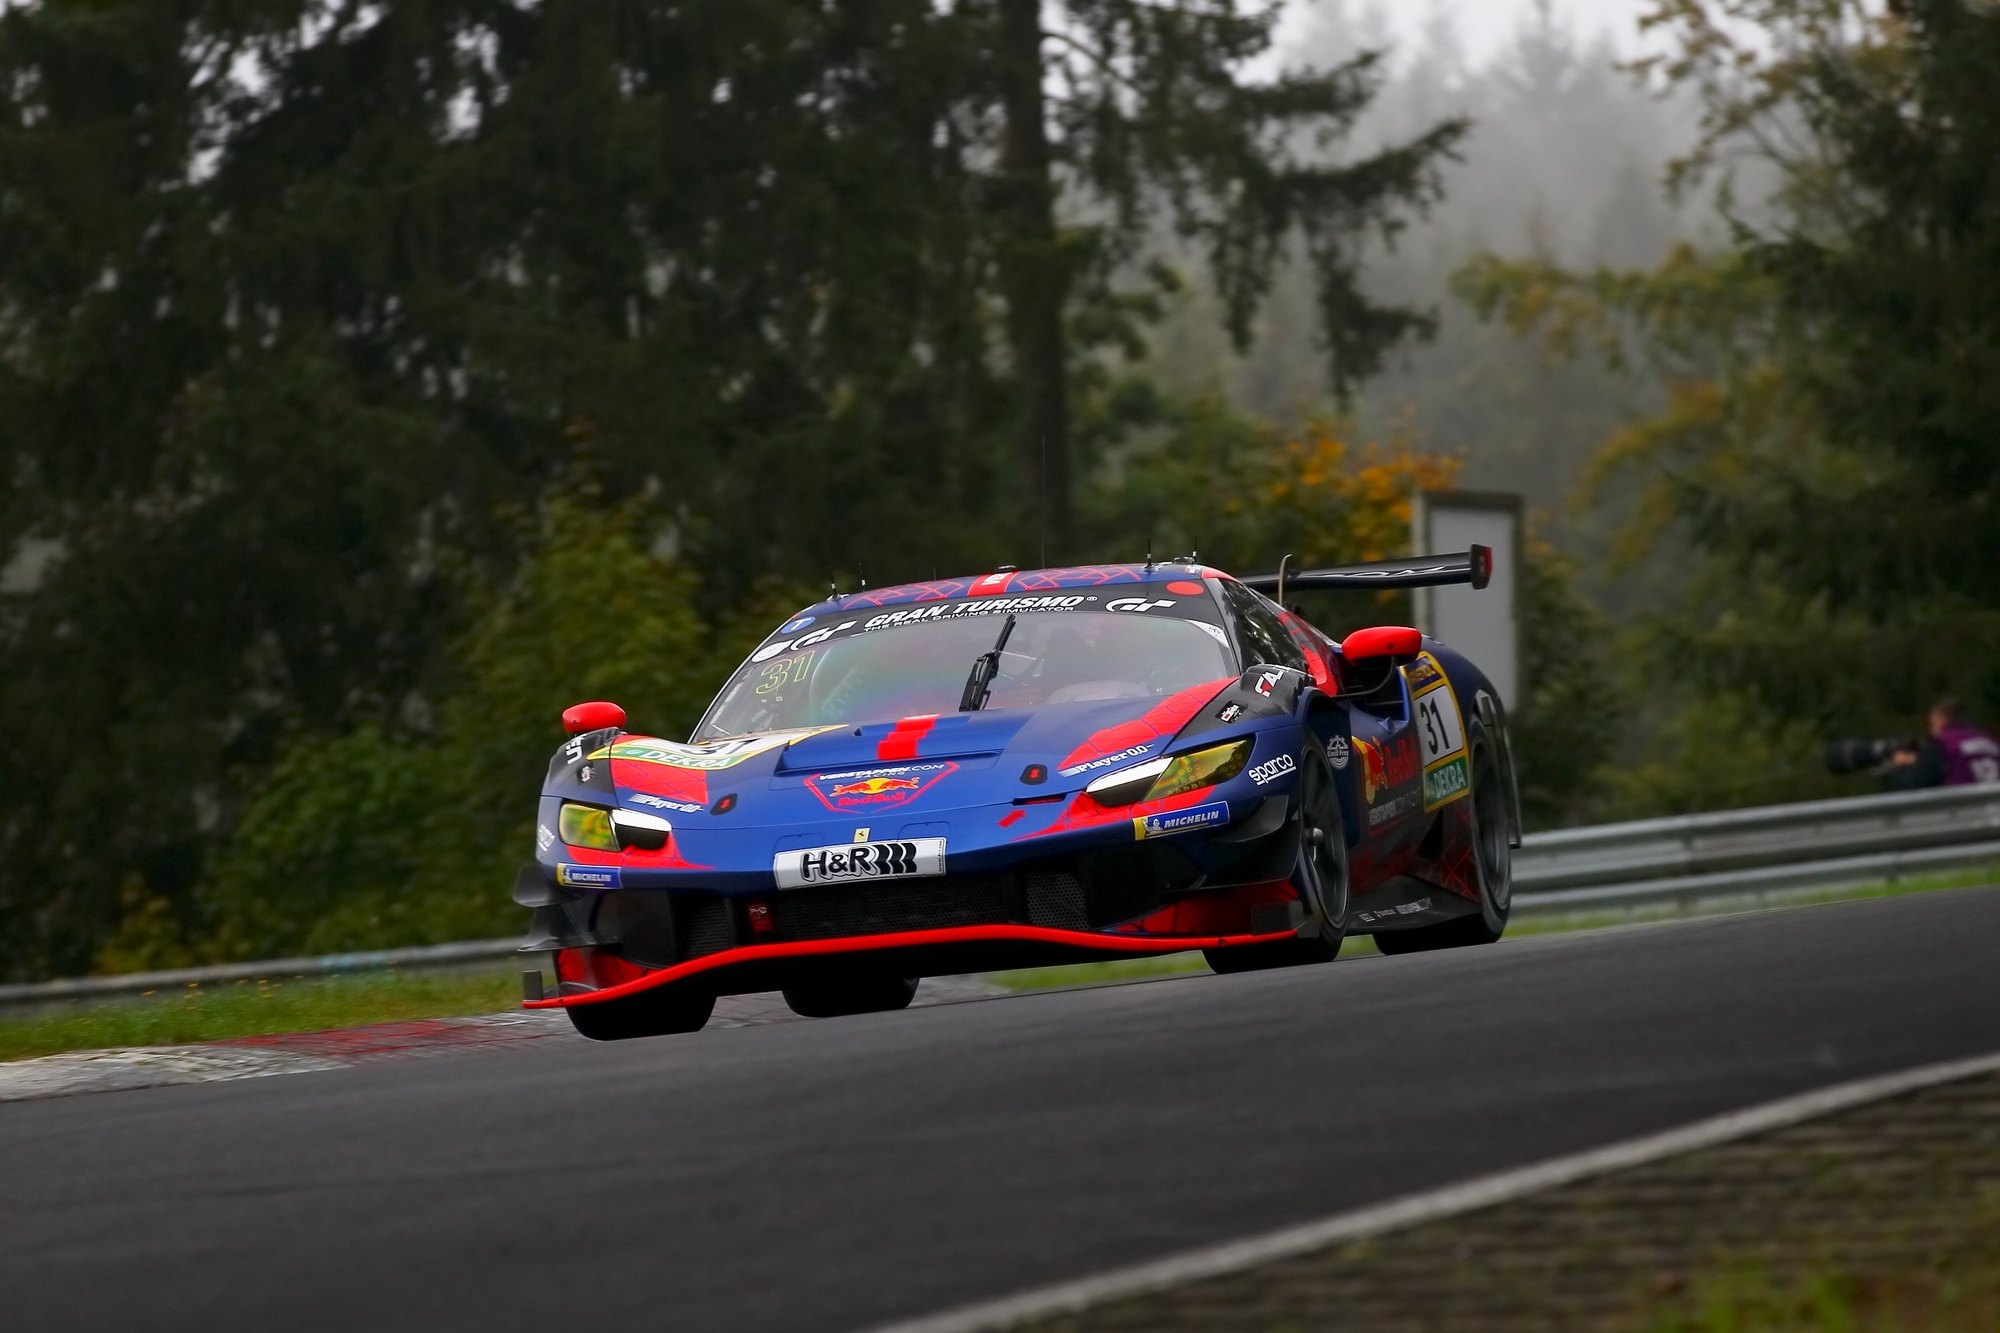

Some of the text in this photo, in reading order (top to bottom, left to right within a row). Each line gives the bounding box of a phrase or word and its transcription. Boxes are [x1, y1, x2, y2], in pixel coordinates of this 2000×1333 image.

[864, 604, 950, 628] GRAN
[864, 606, 1074, 632] THE REAL DRIVING SIMULATOR
[756, 650, 815, 694] 31
[1420, 697, 1450, 755] 31
[639, 750, 732, 767] DEKRA
[1248, 754, 1294, 784] sparco
[1433, 762, 1467, 798] DEKRA
[1164, 811, 1219, 828] MICHELIN
[571, 872, 612, 882] MICHELIN
[802, 847, 874, 880] H&R
